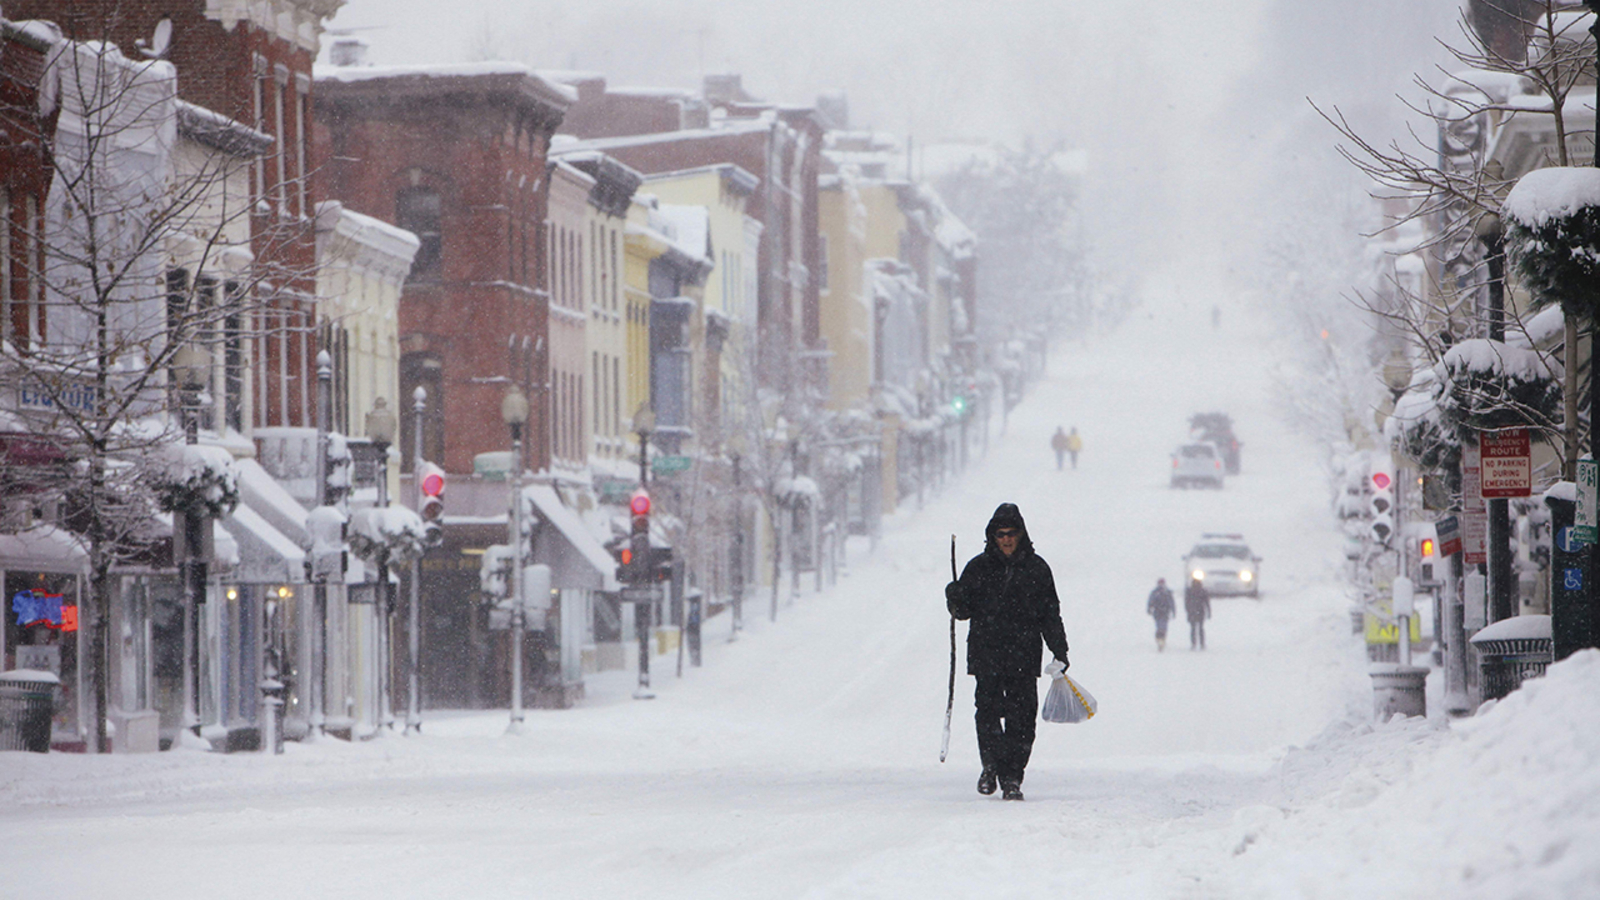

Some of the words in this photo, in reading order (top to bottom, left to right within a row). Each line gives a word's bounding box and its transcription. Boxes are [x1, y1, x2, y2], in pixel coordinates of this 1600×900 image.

[1490, 447, 1521, 455] ROUTE
[1485, 460, 1495, 468] NO
[1497, 459, 1527, 467] PARKING
[1492, 469, 1520, 478] DURING
[1484, 480, 1528, 488] EMERGENCY
